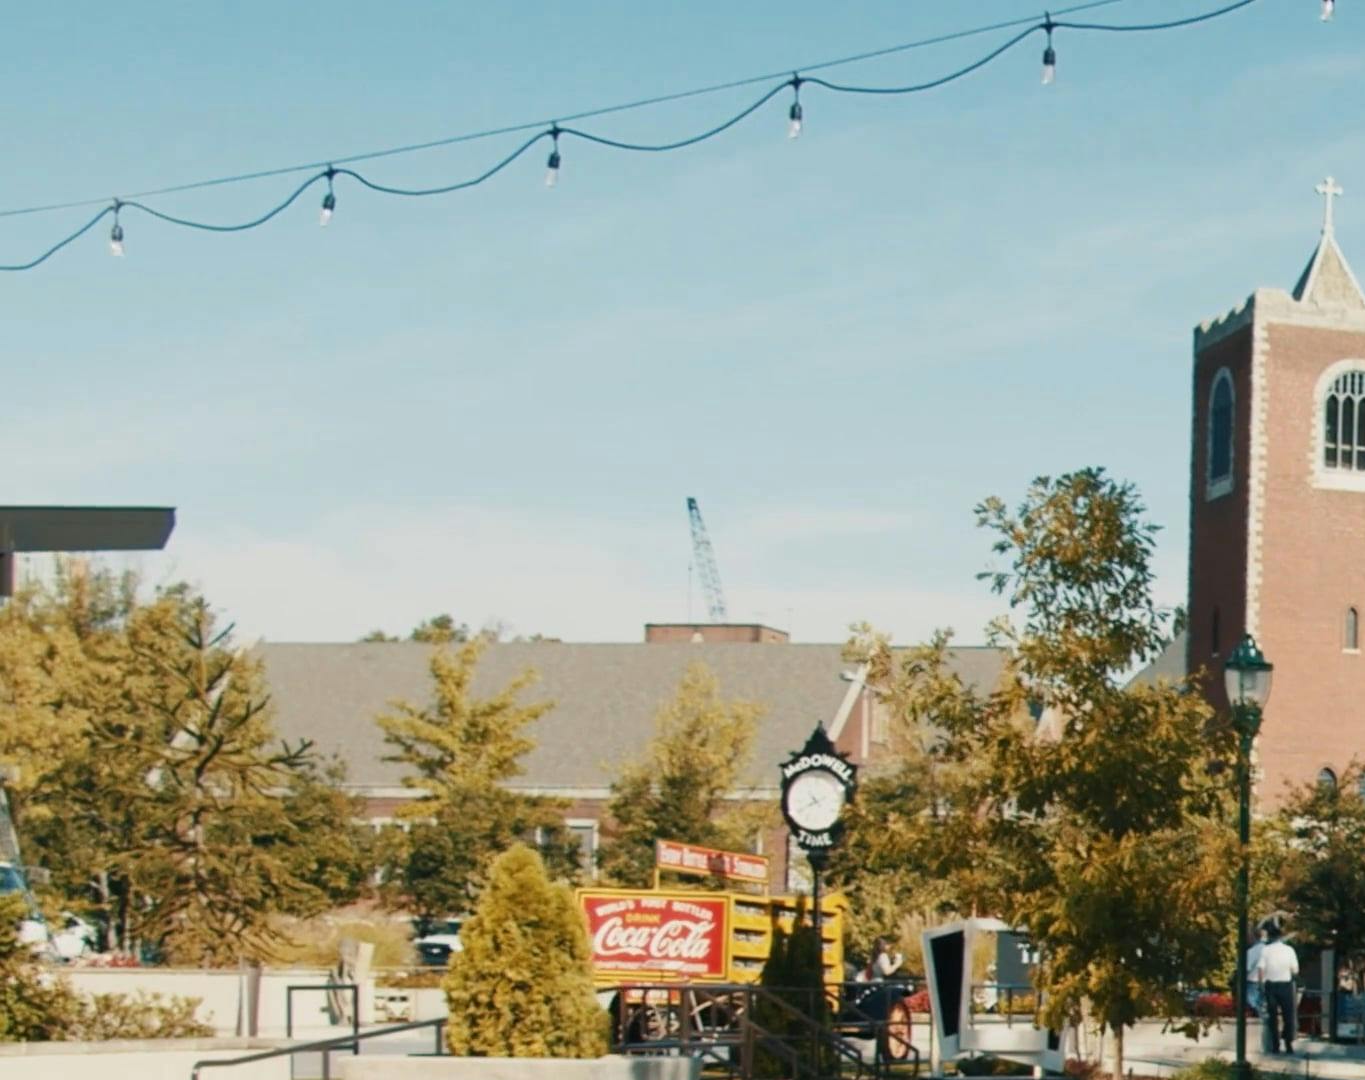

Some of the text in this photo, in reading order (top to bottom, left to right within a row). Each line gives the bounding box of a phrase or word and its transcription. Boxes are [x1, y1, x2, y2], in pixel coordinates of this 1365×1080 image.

[783, 753, 853, 781] McDOWELL
[797, 830, 832, 847] TIME
[624, 912, 662, 924] DRINK
[593, 916, 717, 959] Coca-Cola
